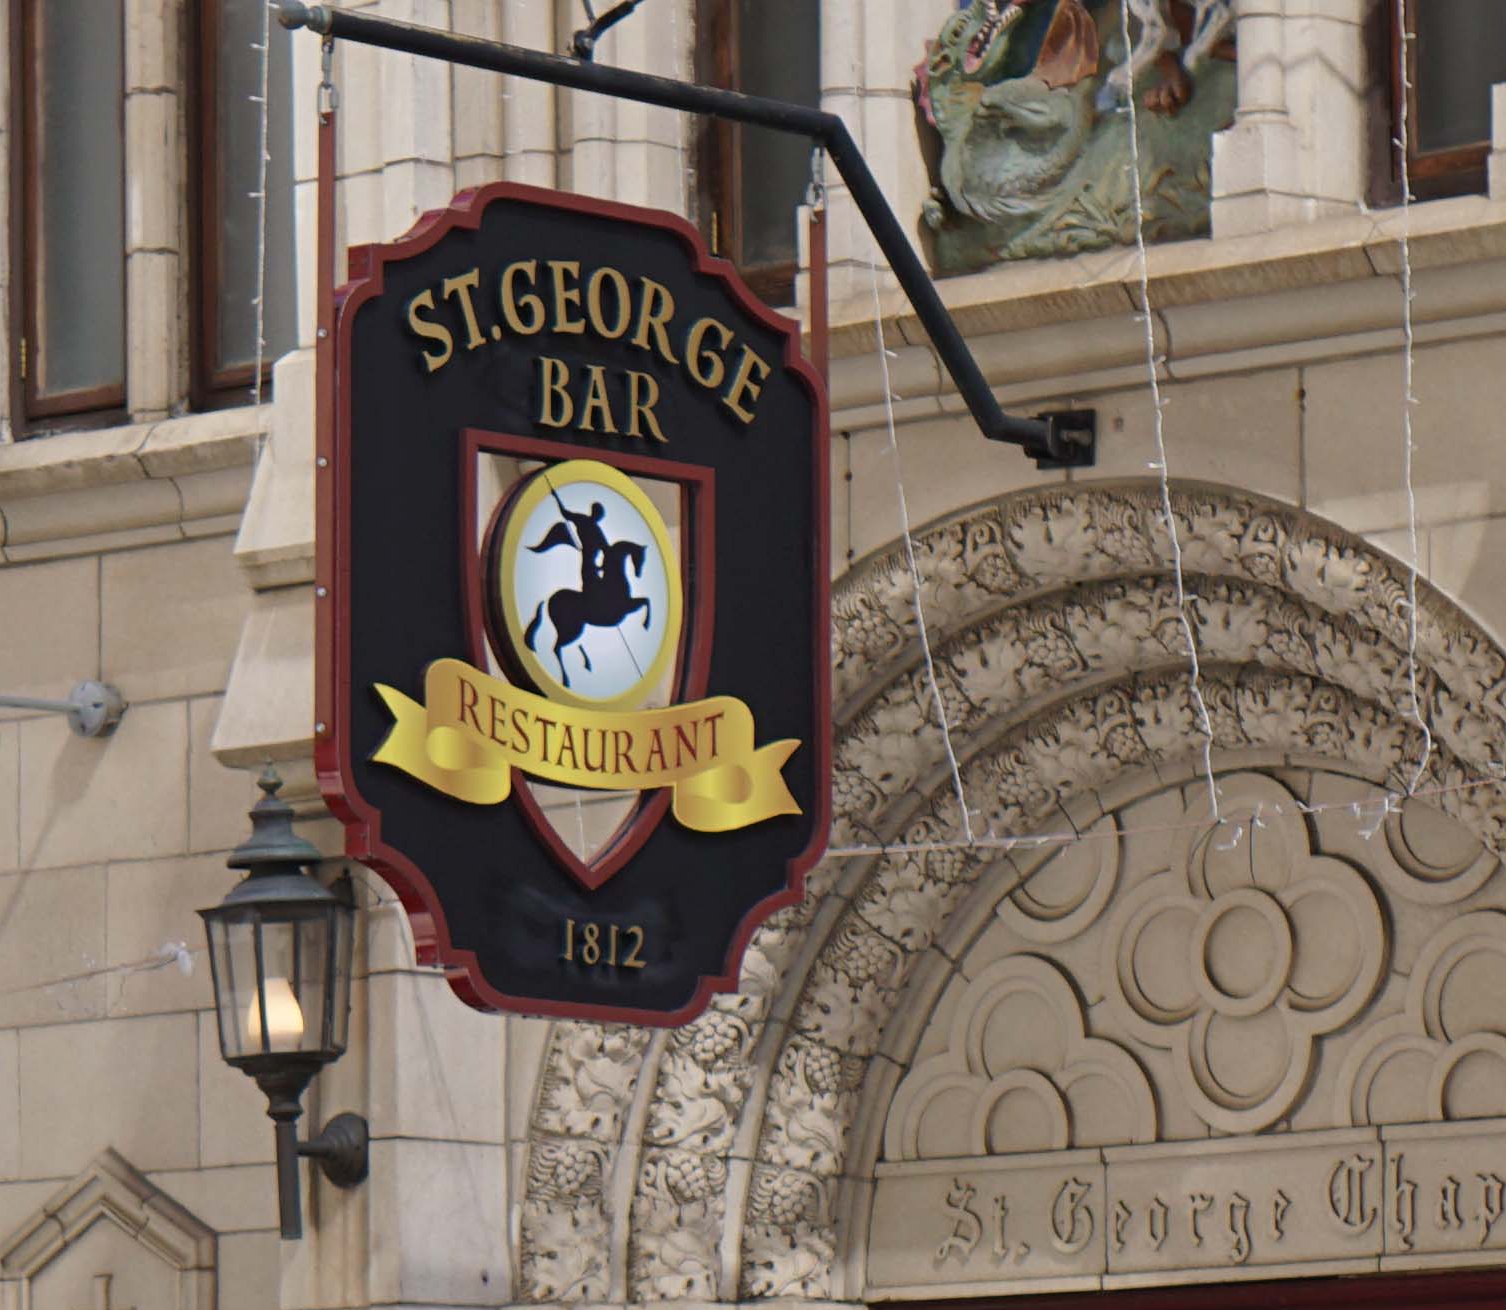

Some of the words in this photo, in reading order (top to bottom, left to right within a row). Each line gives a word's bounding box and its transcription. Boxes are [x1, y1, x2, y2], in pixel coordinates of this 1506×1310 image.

[538, 356, 668, 443] BAR
[458, 677, 725, 774] RESTAURANT
[563, 918, 646, 970] 1812
[933, 1177, 1030, 1268] St.
[1051, 1177, 1292, 1266] George
